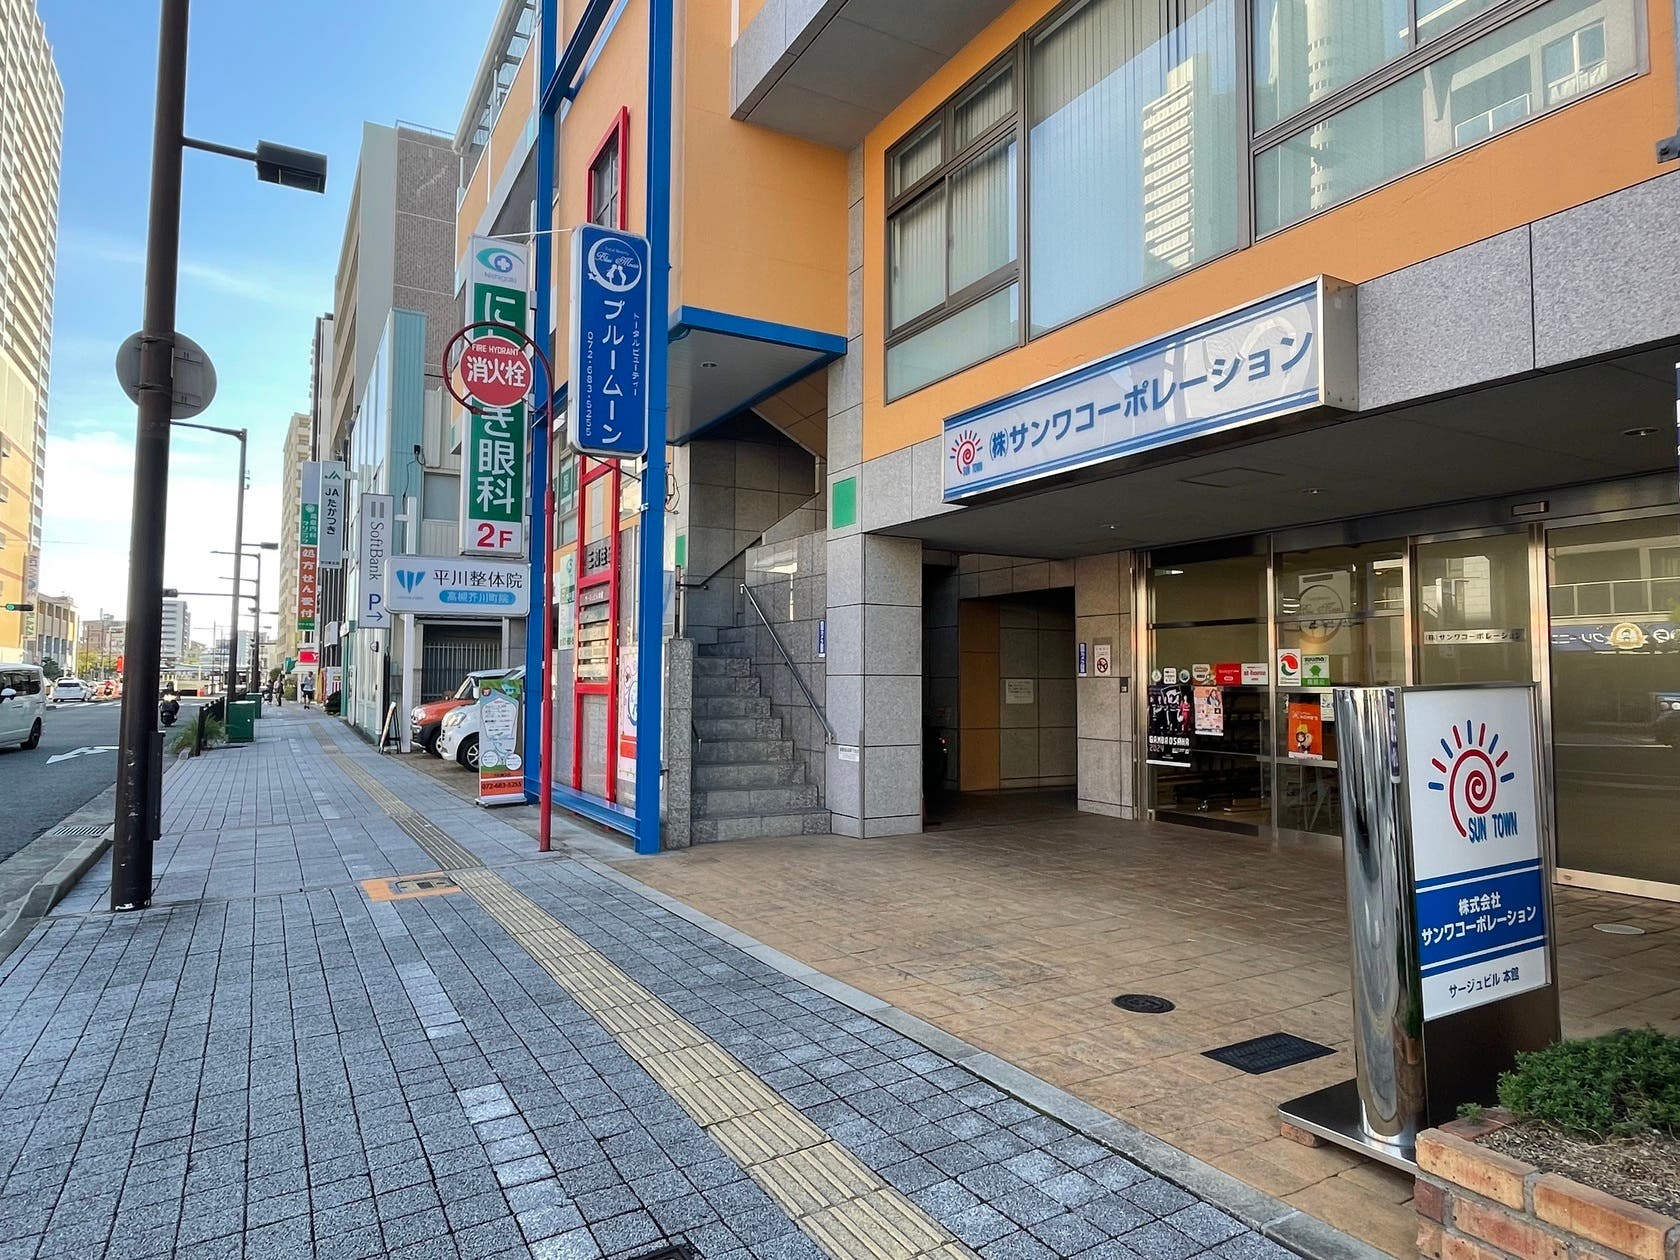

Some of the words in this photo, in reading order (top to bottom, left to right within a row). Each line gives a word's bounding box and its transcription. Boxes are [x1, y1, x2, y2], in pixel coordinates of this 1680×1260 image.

[472, 343, 487, 353] FIRE
[489, 345, 519, 356] HYDRANT
[466, 355, 526, 387] 消火栓
[602, 300, 625, 443] ブルームーン
[369, 521, 384, 580] SoftBank
[477, 522, 513, 548] 2F
[300, 549, 316, 618] 処方せん受付
[433, 569, 523, 589] 平川整体院
[1468, 818, 1487, 843] SUN
[1492, 811, 1518, 838] TOWN
[1458, 892, 1502, 916] 株式会社
[1422, 905, 1537, 946] サンワコーポレーション
